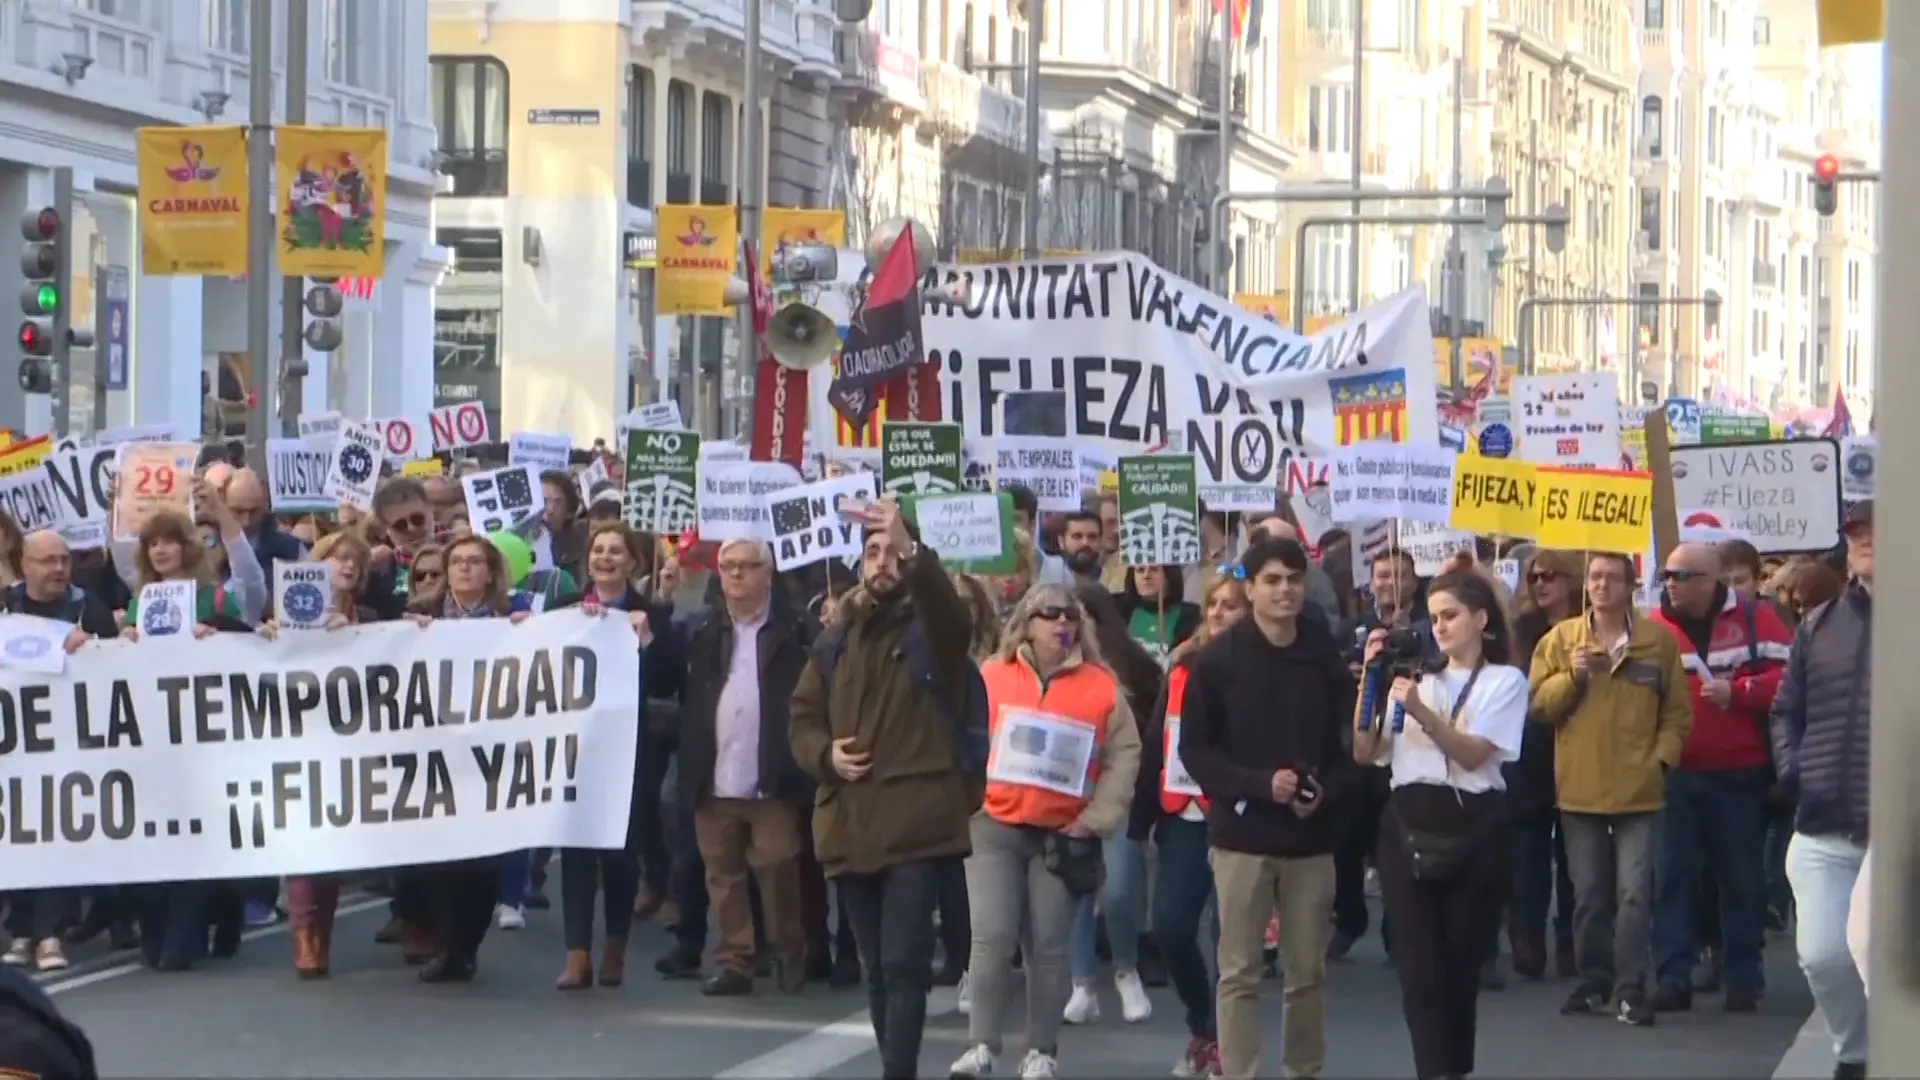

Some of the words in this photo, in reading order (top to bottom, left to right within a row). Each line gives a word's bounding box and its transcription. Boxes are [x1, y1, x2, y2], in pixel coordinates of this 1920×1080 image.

[148, 197, 241, 213] CARNAVAL
[662, 257, 729, 270] CARNAVAL
[1126, 261, 1368, 377] VALENCIANA
[429, 403, 485, 449] NO
[1667, 403, 1699, 427] 25
[646, 433, 682, 454] NO
[1187, 419, 1274, 483] NO
[1708, 448, 1795, 478] IVASS
[135, 465, 174, 495] 29
[1576, 491, 1648, 526] ILEGAL!
[291, 594, 315, 611] 32
[74, 679, 142, 749] LA
[157, 644, 599, 745] TEMPORALIDAD
[0, 768, 203, 844] LICO...
[226, 752, 458, 849] ¡¡FIJEZA
[475, 733, 578, 811] YA!!
